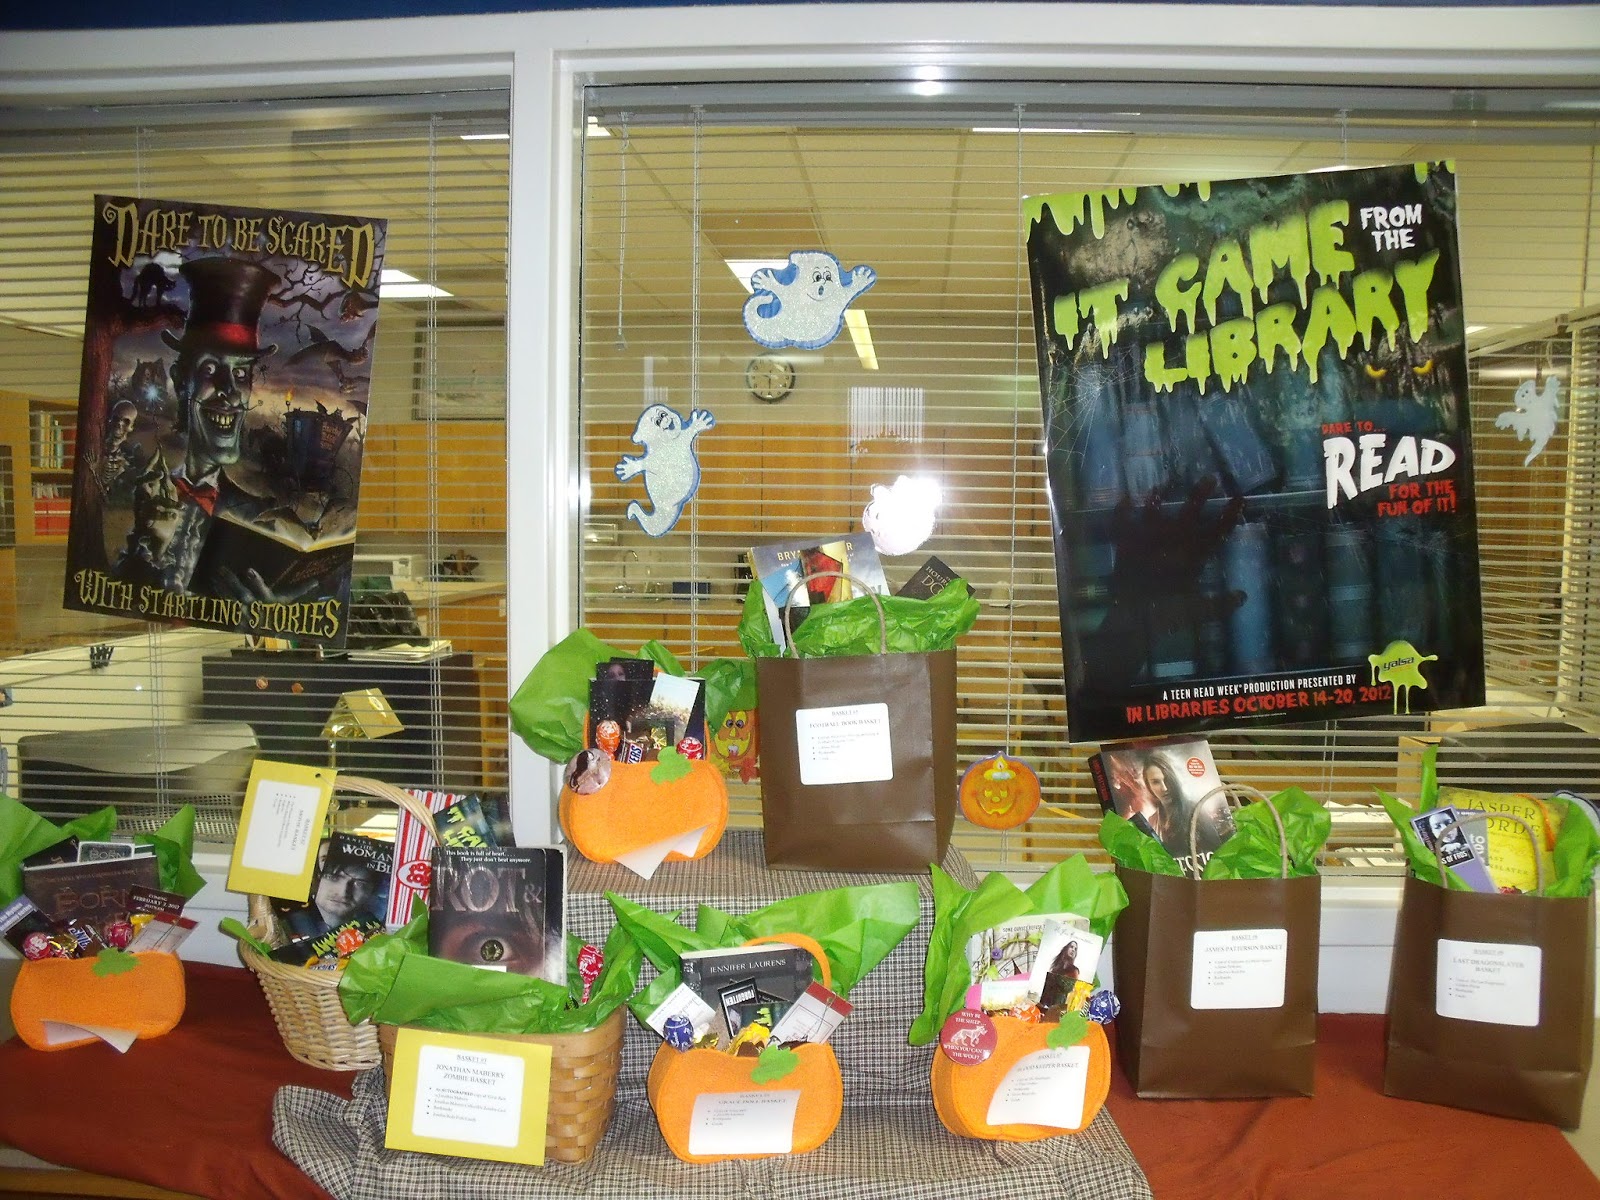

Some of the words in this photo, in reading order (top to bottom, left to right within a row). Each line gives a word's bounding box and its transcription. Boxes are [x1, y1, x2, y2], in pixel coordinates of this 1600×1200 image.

[1360, 203, 1422, 230] FROM
[102, 202, 194, 267] DARE
[198, 214, 229, 249] TO
[231, 216, 263, 251] BE
[265, 215, 375, 288] SCARED
[1371, 228, 1416, 252] THE
[1155, 200, 1354, 334] CAME
[1054, 278, 1129, 359] IT
[1144, 248, 1440, 396] LIBRARY
[1322, 422, 1352, 434] DARE
[1323, 433, 1456, 509] READ
[1388, 483, 1421, 499] FOR
[1426, 480, 1455, 496] THE
[1378, 501, 1407, 517] FUN
[1412, 498, 1433, 514] OF
[74, 568, 133, 610] WITH
[139, 585, 242, 626] STARTLING
[249, 598, 342, 638] STORIES
[1383, 657, 1414, 671] yalsa
[1163, 691, 1168, 700] A
[1171, 689, 1191, 700] TEEN
[1194, 687, 1214, 698] READ
[1244, 678, 1294, 694] PRODUCTION
[1298, 676, 1343, 689] PRESENTED
[1346, 674, 1356, 685] BY
[1126, 706, 1142, 724] IN
[1146, 698, 1230, 721] LIBRARIES
[1233, 692, 1309, 712] OCTOBER
[1359, 685, 1392, 701] 2012
[1467, 799, 1536, 821] JASPER
[342, 844, 392, 862] WOMAN
[430, 866, 526, 913] ROT
[524, 883, 543, 903] &
[710, 963, 746, 974] JENNIFER
[749, 959, 787, 970] LAURENS
[436, 1064, 471, 1074] JONATHAN
[472, 1068, 505, 1079] MABERRY
[470, 1076, 496, 1085] BASKET
